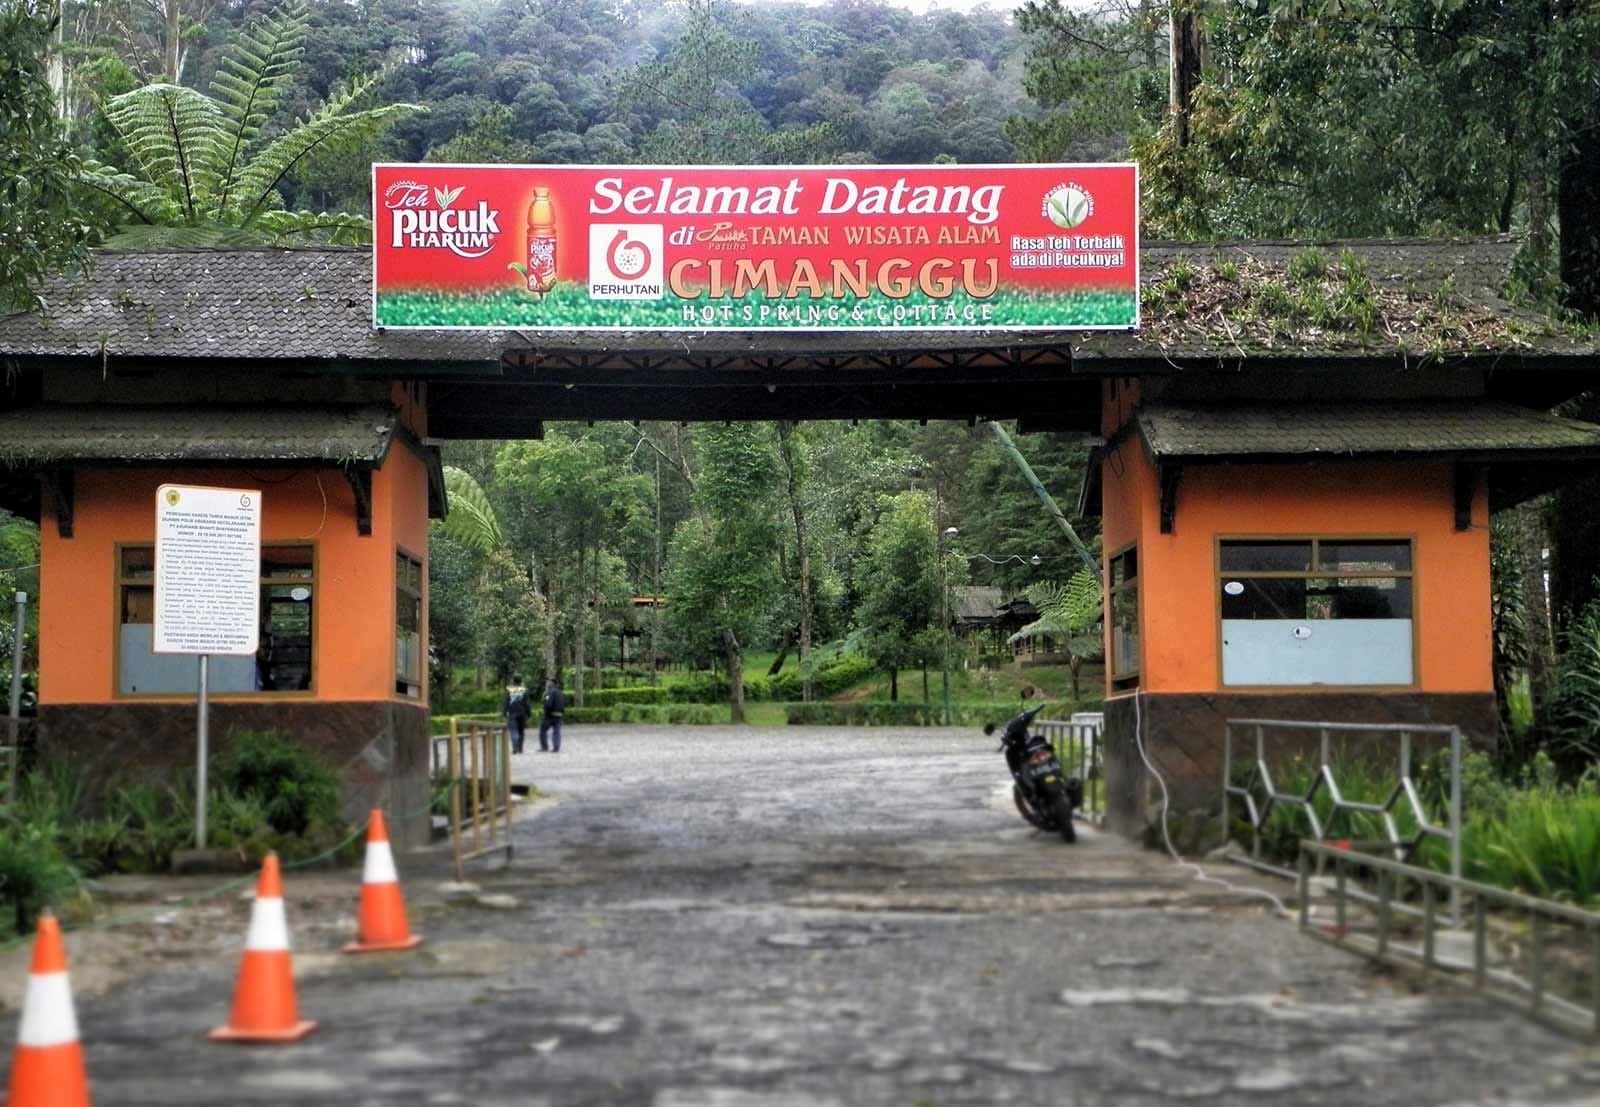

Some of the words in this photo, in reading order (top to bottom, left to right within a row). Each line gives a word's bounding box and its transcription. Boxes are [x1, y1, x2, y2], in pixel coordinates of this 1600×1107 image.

[385, 184, 430, 208] Teh
[589, 177, 803, 215] Selamat
[818, 177, 1005, 224] Datang
[391, 200, 500, 248] pucuk
[410, 232, 492, 255] HARUM
[669, 225, 696, 246] di
[748, 226, 829, 245] TAMAN
[845, 226, 930, 245] WISATA
[937, 226, 1002, 245] ALAM
[1012, 236, 1045, 250] Rasa
[1047, 236, 1071, 250] Teh
[1074, 235, 1124, 250] Terbaik
[1012, 253, 1036, 266] ada
[1039, 253, 1051, 266] di
[1055, 252, 1124, 267] Pucuknya!
[669, 257, 1000, 299] CIMANGGU
[592, 284, 660, 296] PERHUTANI
[683, 304, 733, 322] HOT
[742, 304, 840, 322] SPRING
[851, 305, 865, 321] &
[877, 304, 992, 321] COTTAGE
